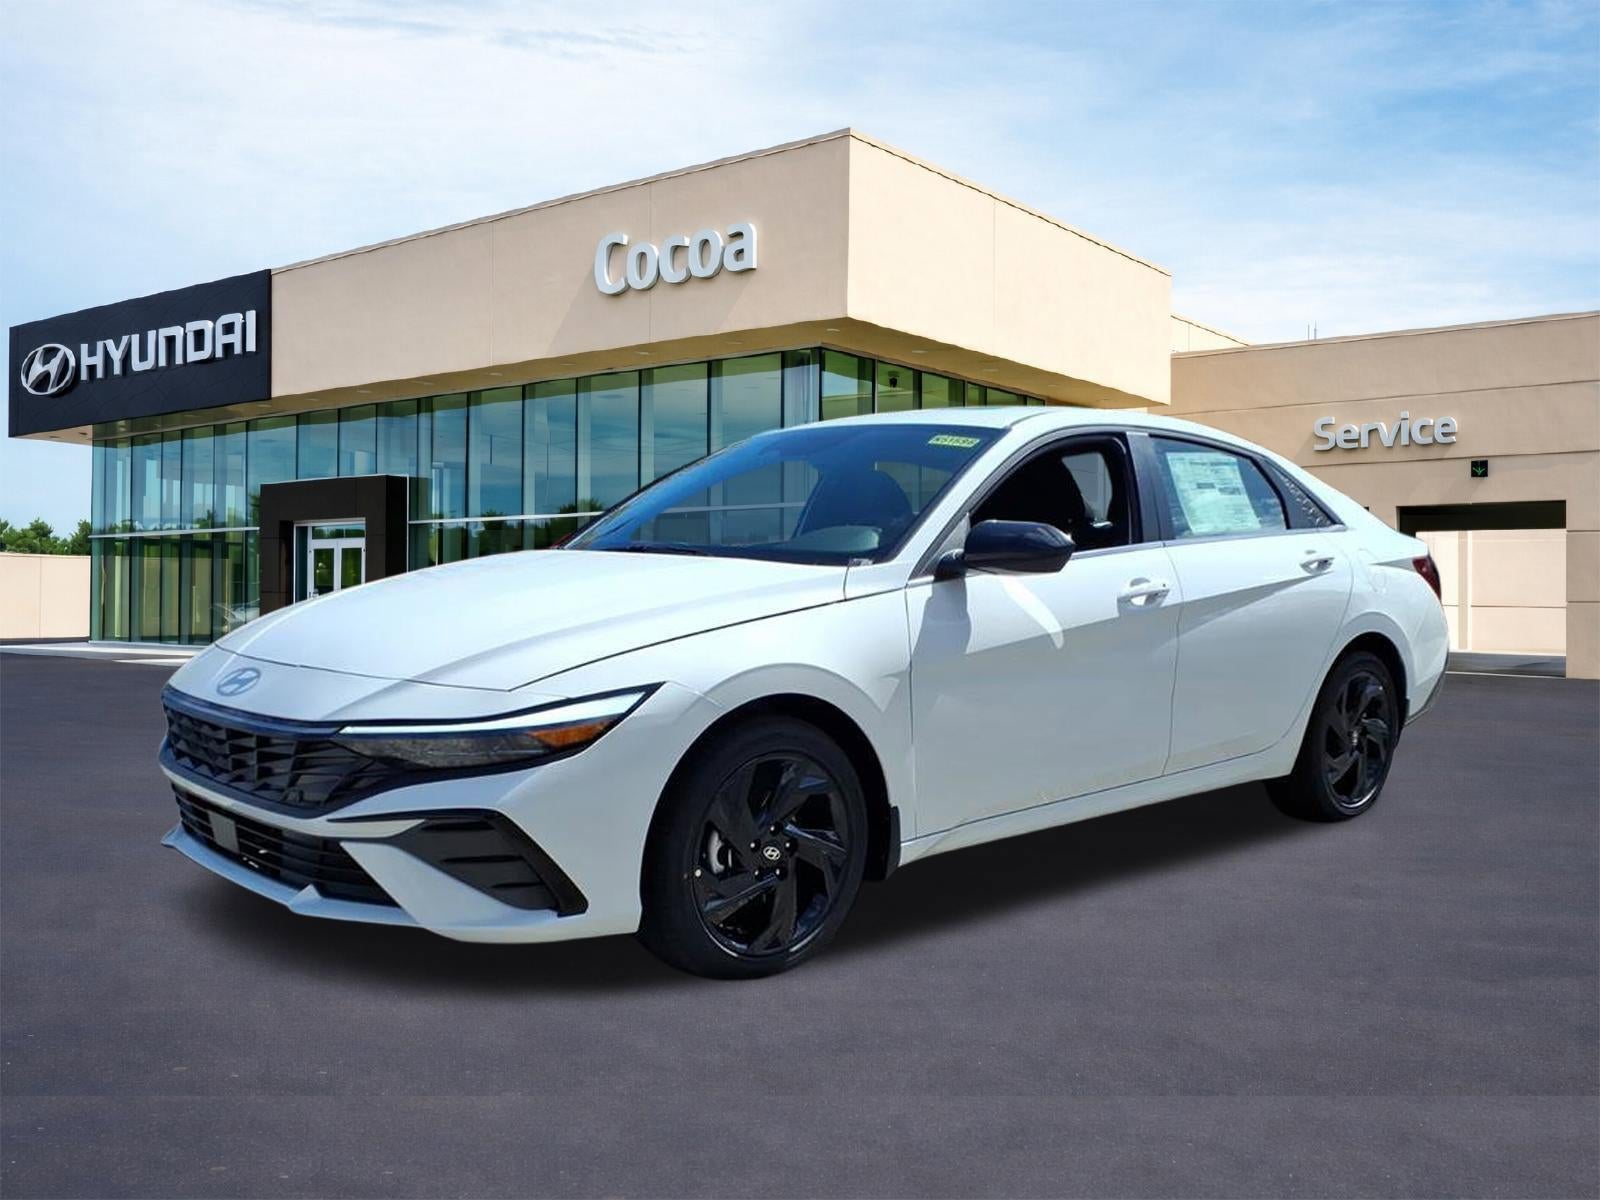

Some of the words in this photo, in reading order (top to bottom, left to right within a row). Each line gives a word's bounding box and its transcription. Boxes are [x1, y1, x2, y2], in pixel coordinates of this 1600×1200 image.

[593, 222, 758, 296] Cocoa
[80, 310, 257, 381] HYUNDAI
[1312, 410, 1459, 452] Service
